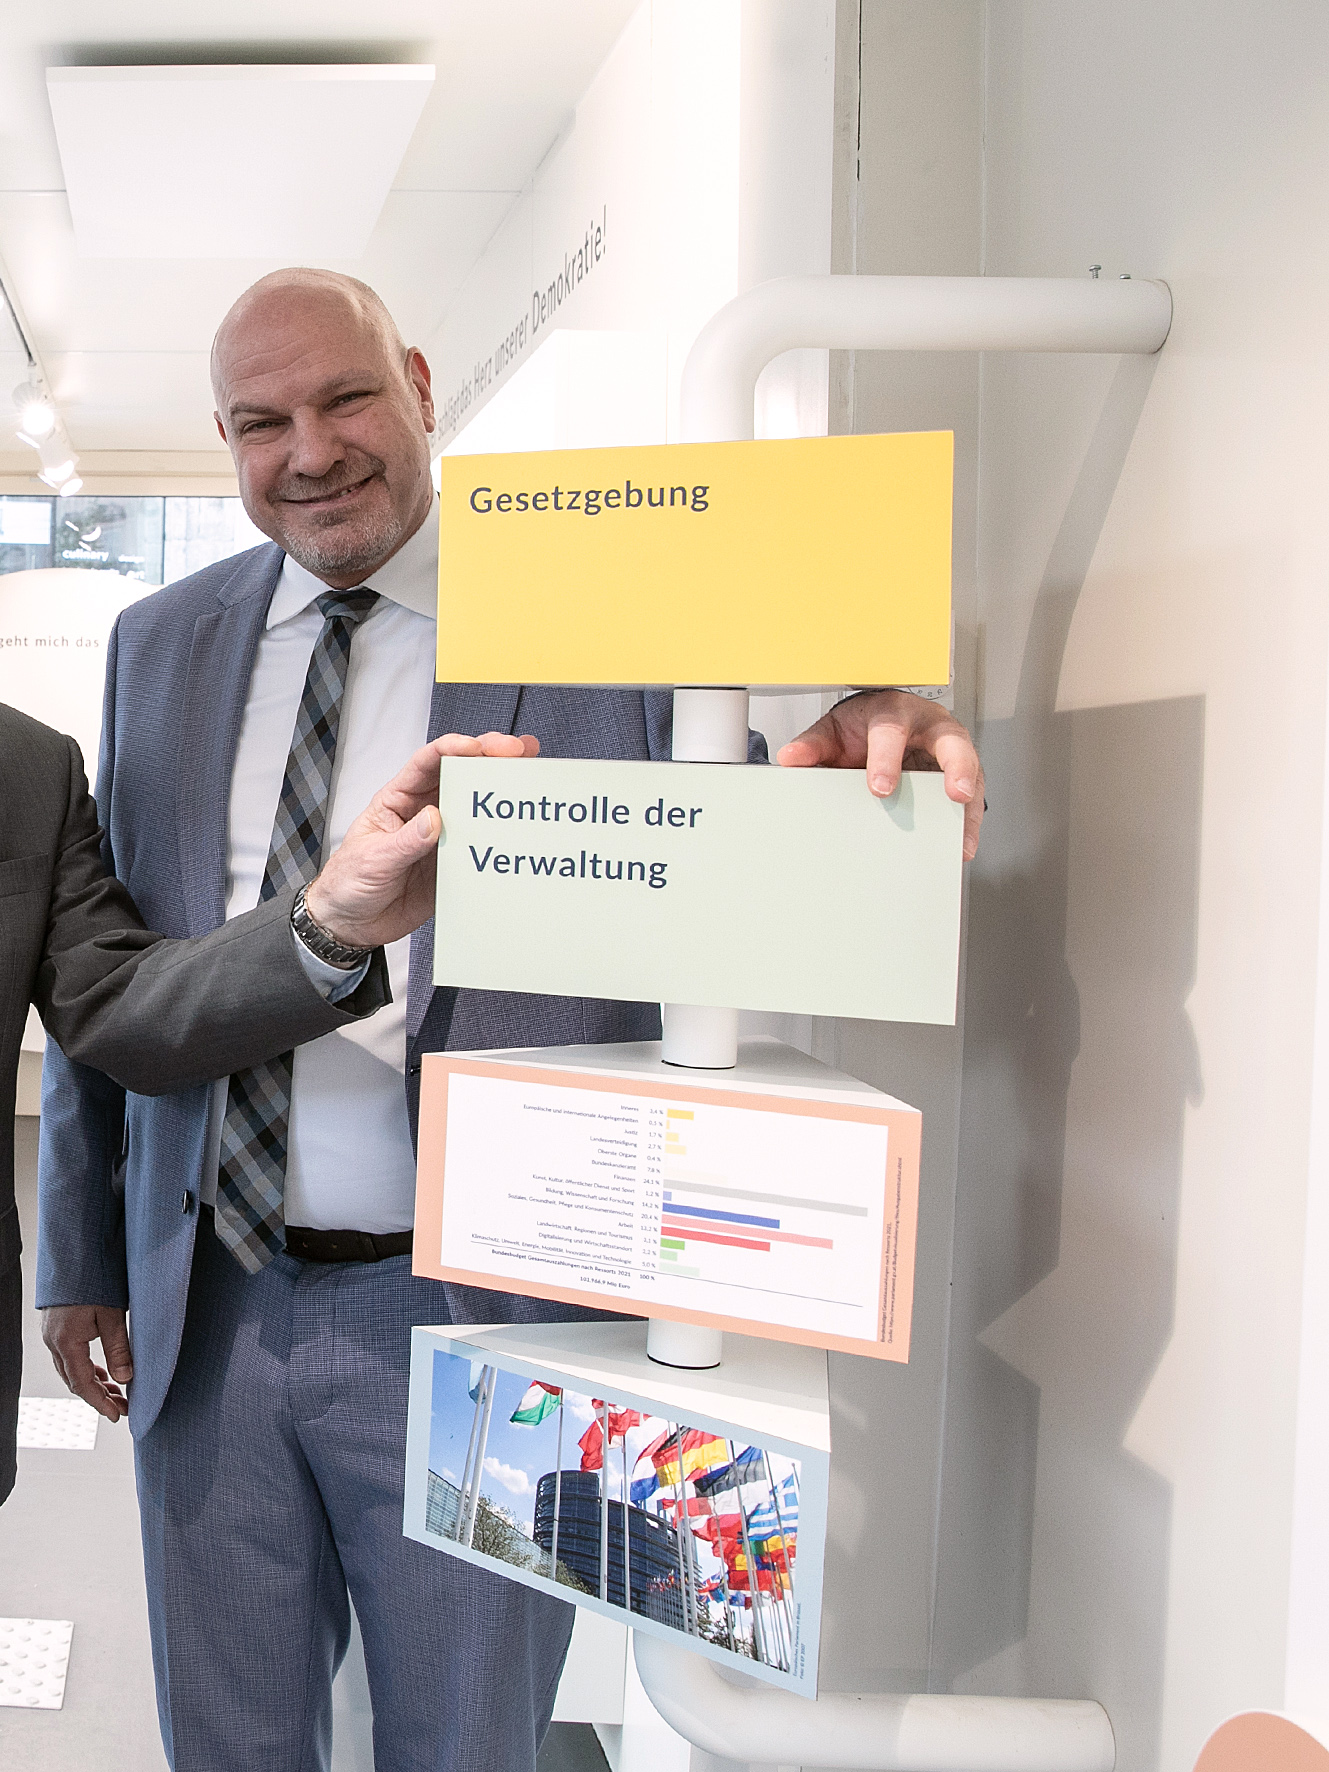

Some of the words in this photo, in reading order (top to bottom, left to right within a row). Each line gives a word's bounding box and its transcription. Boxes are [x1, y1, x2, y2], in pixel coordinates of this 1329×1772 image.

[474, 357, 492, 400] Herz
[494, 311, 528, 377] unserer
[532, 204, 606, 335] Demokratie!
[470, 480, 710, 516] Gesetzgebung
[36, 636, 68, 648] mich
[76, 636, 100, 648] das
[472, 792, 630, 825] Kontrolle
[644, 798, 702, 828] der
[469, 845, 668, 888] Verwaltung
